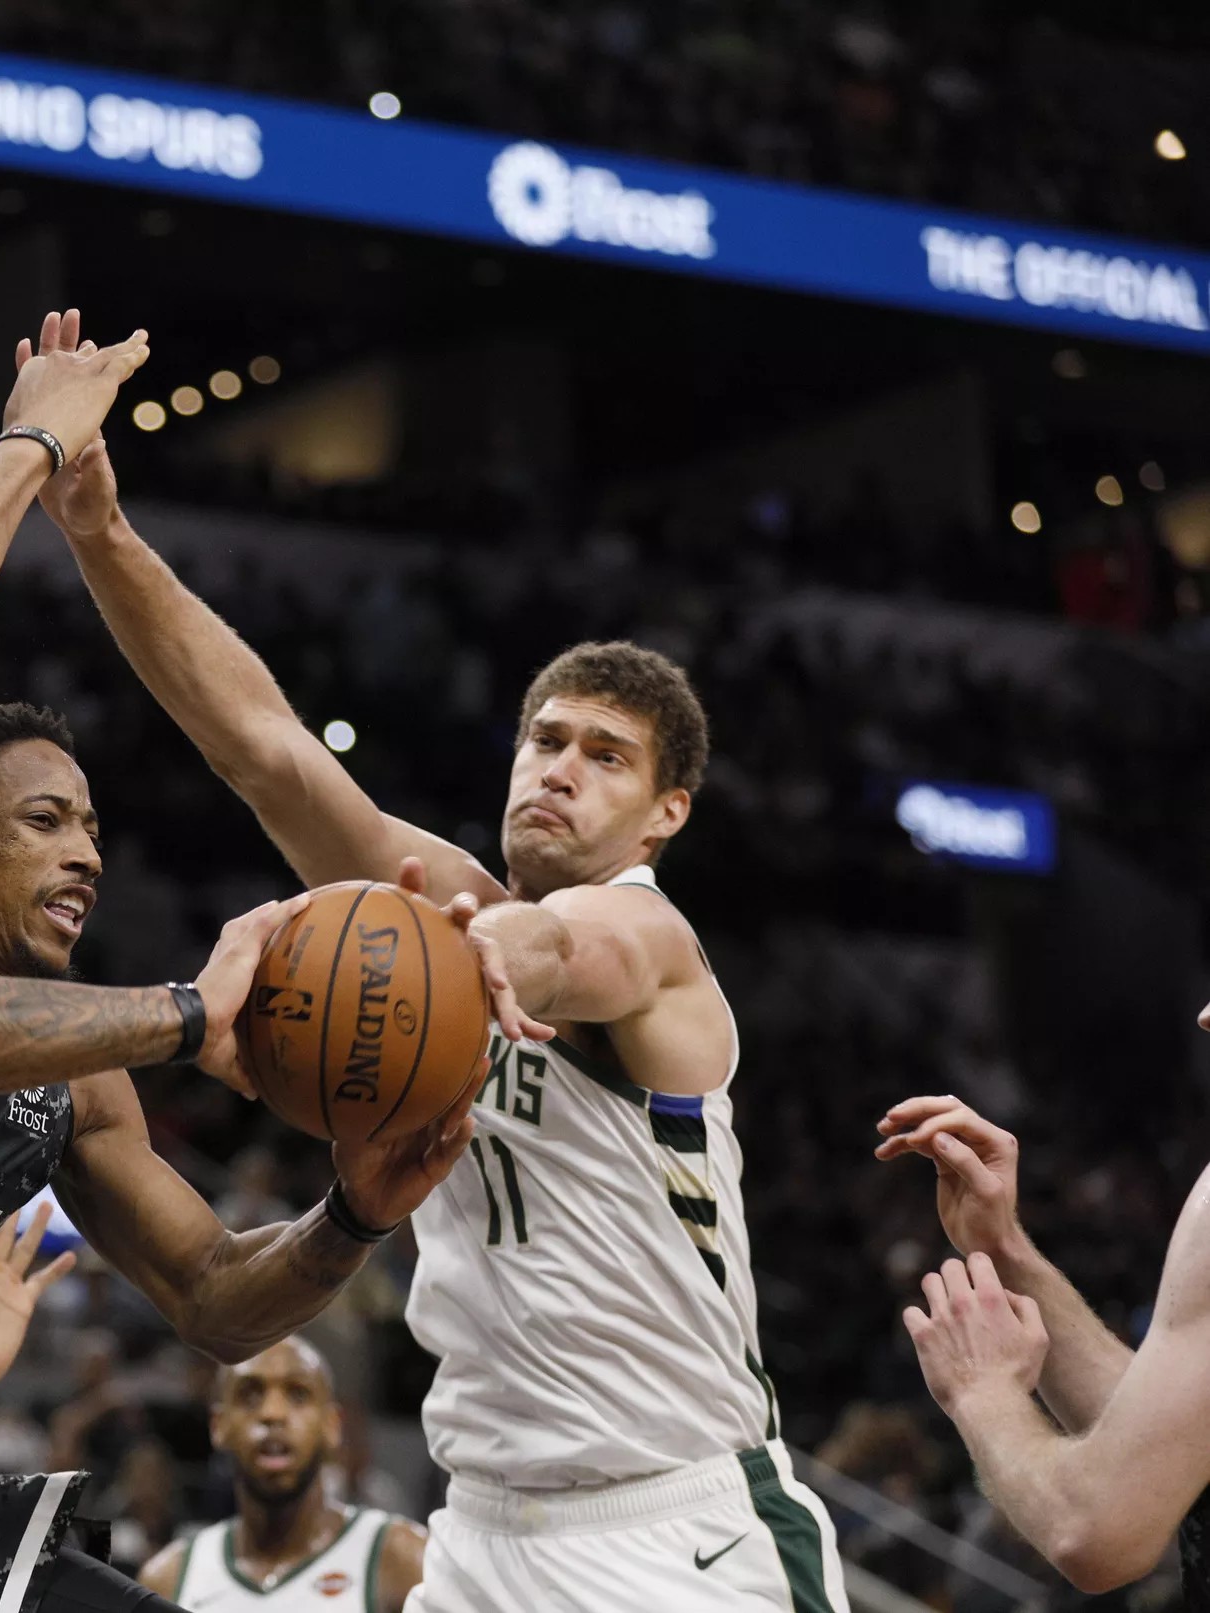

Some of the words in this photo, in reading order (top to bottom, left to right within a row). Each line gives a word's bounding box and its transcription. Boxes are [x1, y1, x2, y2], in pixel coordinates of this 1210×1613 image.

[87, 94, 264, 180] SPURS
[920, 225, 1015, 300] THE
[1014, 241, 1209, 331] OFFICIAL
[335, 923, 400, 1104] SPALDING
[7, 1098, 50, 1134] Frost
[469, 1134, 531, 1248] 11
